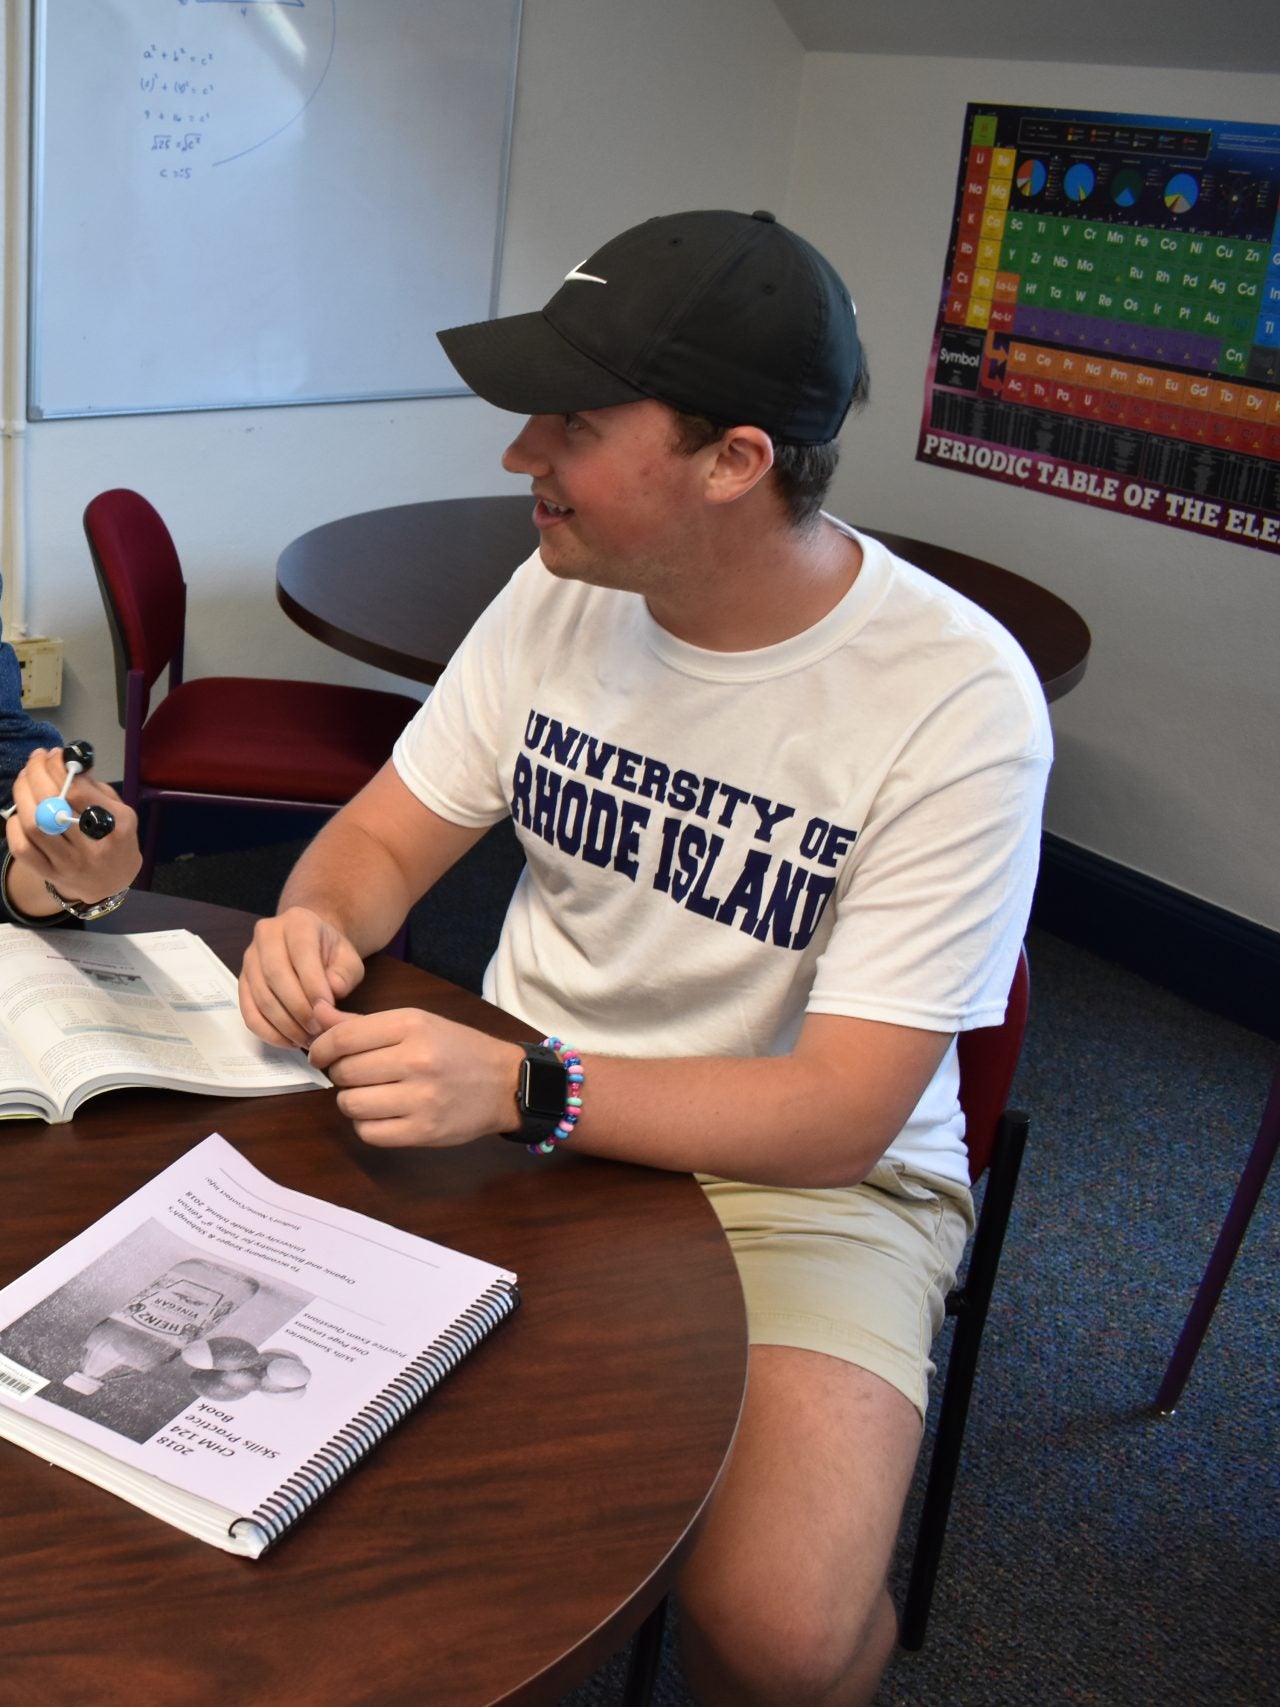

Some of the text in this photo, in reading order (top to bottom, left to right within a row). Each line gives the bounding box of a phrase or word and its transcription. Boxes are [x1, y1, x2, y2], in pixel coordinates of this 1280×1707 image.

[969, 184, 983, 194] Na
[968, 214, 975, 224] K
[1010, 219, 1023, 230] Sc
[1038, 222, 1046, 233] Ti
[1062, 226, 1070, 236] V
[1084, 229, 1097, 240] Cr
[1107, 232, 1124, 244] Mn
[1135, 235, 1149, 247] Fe
[1160, 238, 1177, 251] Co
[1190, 242, 1203, 254] Ni
[1216, 245, 1233, 258] Cu
[1245, 249, 1260, 262] Zn
[1273, 254, 1280, 265] G
[1009, 249, 1016, 261] Y
[1031, 252, 1042, 264] Zr
[1053, 256, 1068, 268] Nb
[1077, 260, 1094, 272] Mo
[1130, 267, 1143, 280] Ru
[1156, 270, 1170, 284] Rh
[1183, 274, 1198, 288] Pd
[1209, 279, 1226, 294] Ag
[1237, 283, 1257, 296] Cd
[956, 272, 968, 284] Cs
[1026, 283, 1037, 294] Hf
[1050, 286, 1062, 299] Ta
[1076, 290, 1087, 302] W
[1099, 294, 1112, 307] Re
[1124, 298, 1138, 311] Os
[1153, 303, 1162, 315] Ir
[1179, 307, 1191, 320] Pt
[1204, 312, 1221, 325] Au
[952, 301, 962, 312] Fr
[1226, 349, 1243, 362] Cn
[940, 348, 980, 368] Symbol
[1014, 350, 1028, 362] La
[1036, 354, 1052, 367] Ce
[1085, 363, 1102, 376] Nd
[1110, 368, 1128, 382] Pm
[1136, 373, 1154, 386] Sm
[1165, 378, 1179, 391] Eu
[1190, 384, 1208, 398] Gd
[1220, 389, 1234, 402] Tb
[1246, 395, 1263, 409] Dy
[1008, 379, 1022, 391] Ac
[1033, 384, 1045, 395] Th
[1056, 389, 1070, 402] Pa
[1084, 394, 1092, 406] U
[923, 434, 1033, 480] PERIODIC
[1037, 459, 1120, 502] TABLE
[1123, 484, 1160, 511] OF
[1165, 492, 1222, 529] THE
[1225, 508, 1280, 545] ELE
[524, 709, 858, 868] UNIVERSITY OF
[510, 750, 837, 952] RHODE ISLAND
[177, 1198, 203, 1220] Edition
[185, 1191, 205, 1207] 2018
[230, 1222, 255, 1235] Rhode
[241, 1236, 254, 1245] for
[256, 1231, 265, 1240] of
[216, 1237, 243, 1252] Seager
[253, 1240, 305, 1264] Biochemistry
[265, 1235, 306, 1253] University
[244, 1248, 289, 1269] accompany
[305, 1261, 322, 1270] and
[324, 1268, 356, 1285] Organic
[151, 1296, 200, 1320] VINEGAR
[136, 1311, 180, 1334] HEINZ
[284, 1328, 355, 1363] Skills Summaries
[293, 1320, 370, 1356] One Page Lessons
[302, 1312, 408, 1359] Practice Exam Questions
[196, 1402, 234, 1424] Book
[156, 1435, 195, 1456] 2018
[169, 1425, 236, 1458] CHM 124
[184, 1413, 280, 1460] Skills Practice
